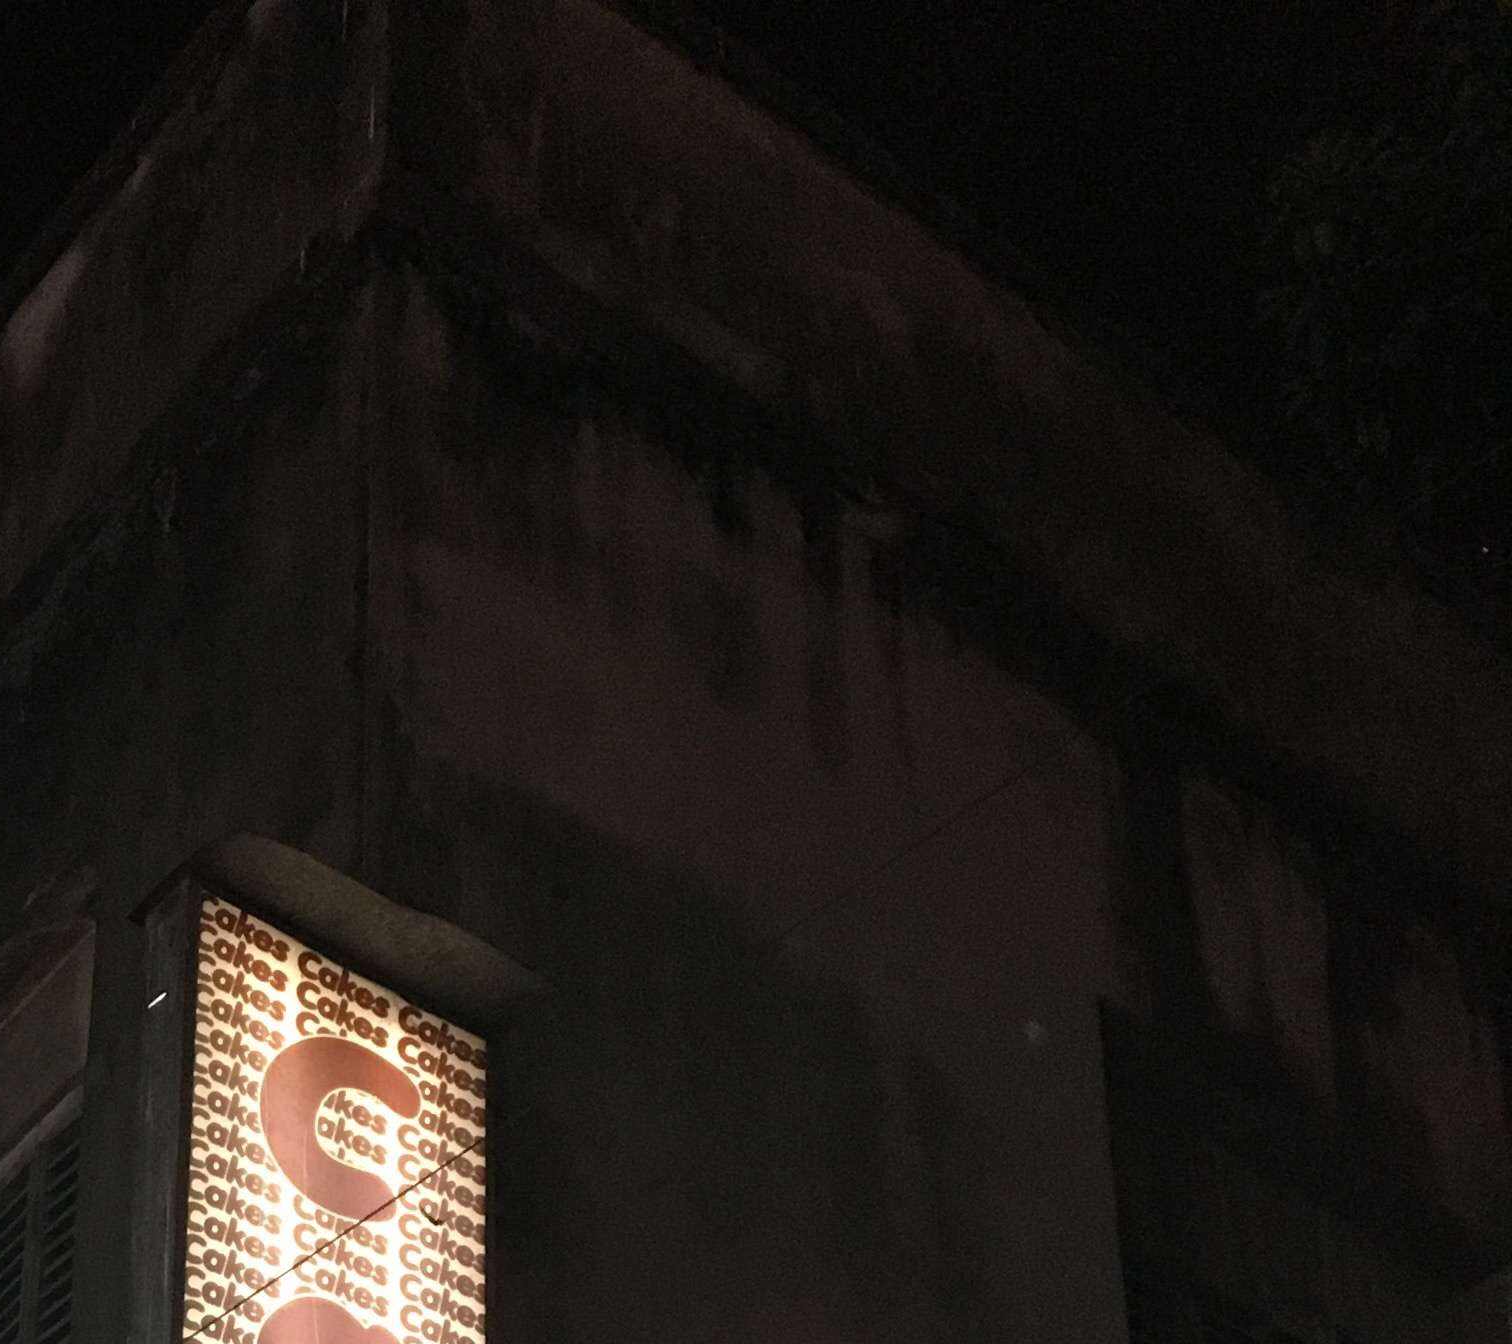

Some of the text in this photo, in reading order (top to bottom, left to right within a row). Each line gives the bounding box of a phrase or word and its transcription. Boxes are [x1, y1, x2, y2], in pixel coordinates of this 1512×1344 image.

[198, 953, 286, 1022] Cakes
[199, 923, 288, 992] Cakes
[296, 981, 389, 1048] Cakes
[201, 893, 290, 963] Cakes
[297, 954, 389, 1021] Cakes
[190, 1139, 281, 1204] Cakes
[318, 1117, 388, 1165] akes
[187, 1202, 281, 1266] Cakes
[293, 1254, 388, 1318] Cakes
[188, 1171, 281, 1235] Cakes
[293, 1223, 388, 1286] Cakes
